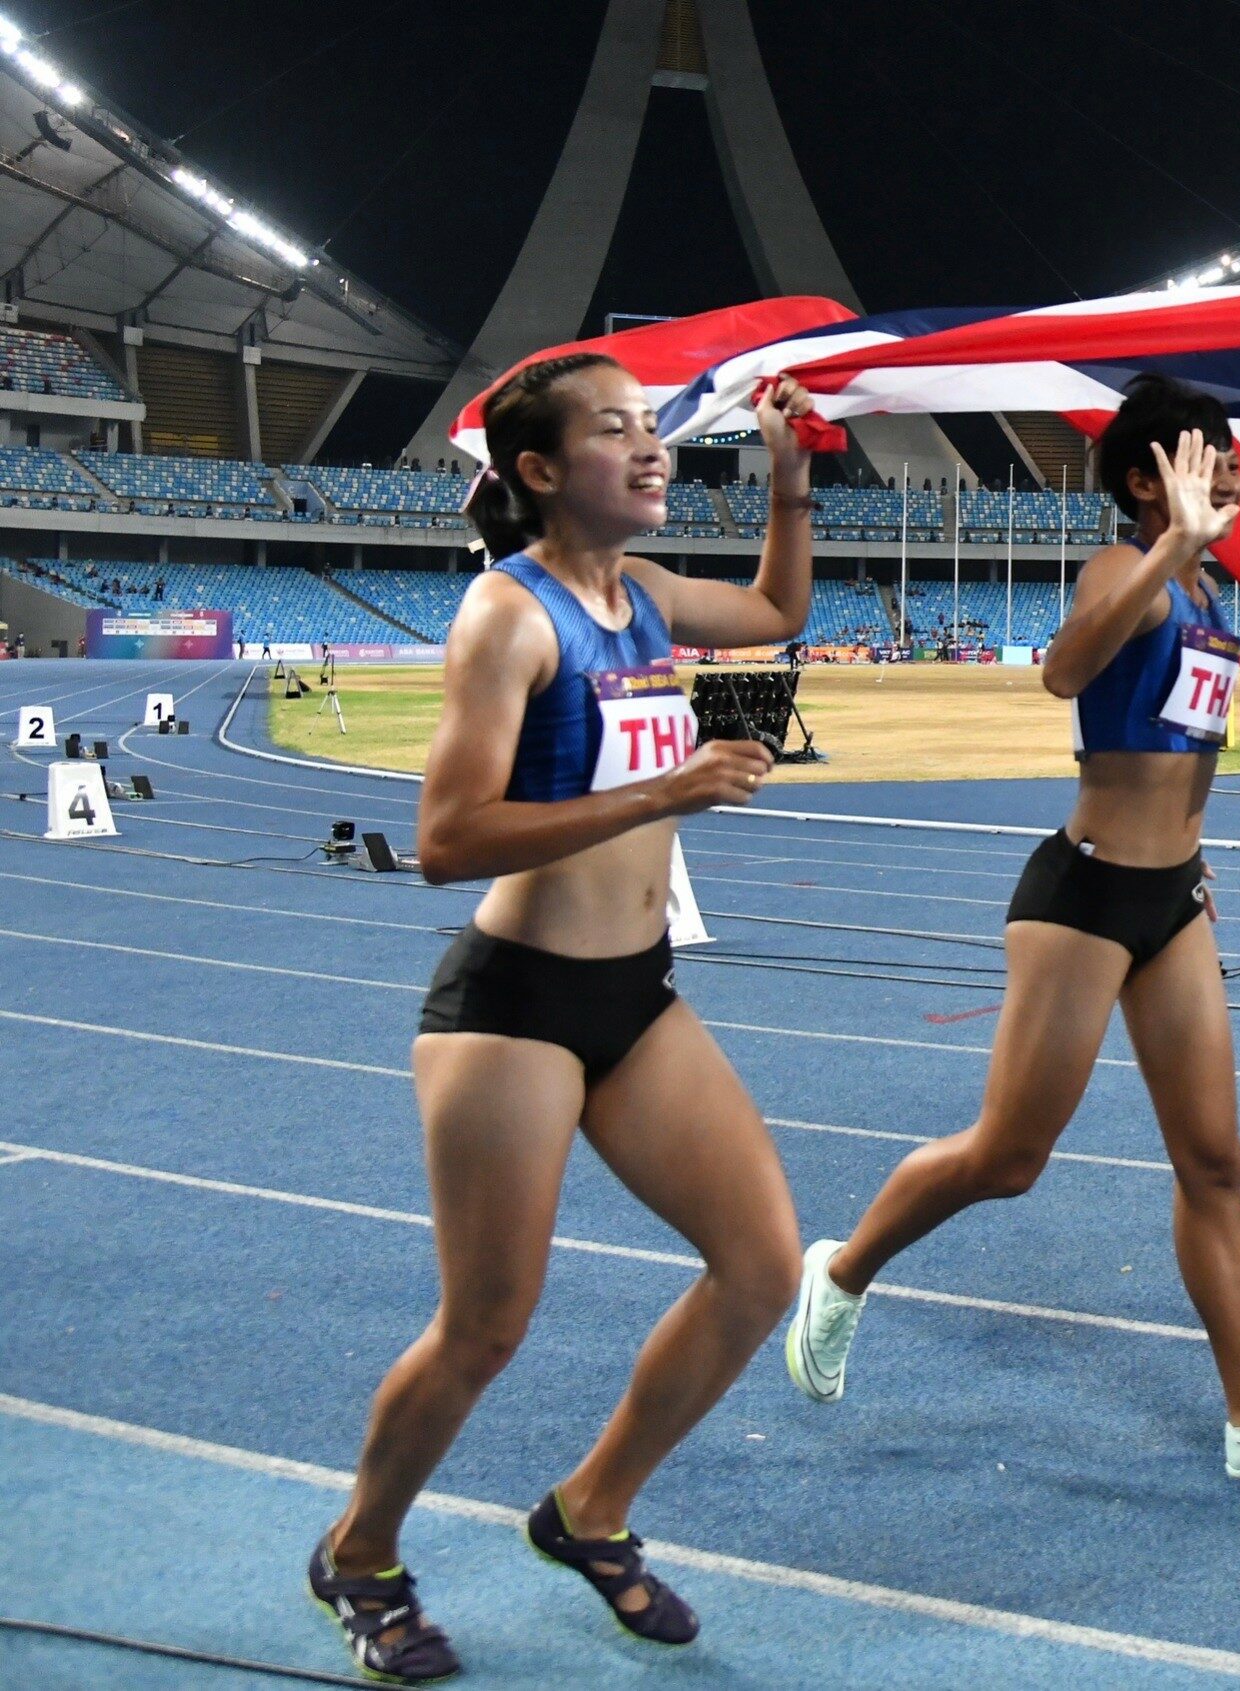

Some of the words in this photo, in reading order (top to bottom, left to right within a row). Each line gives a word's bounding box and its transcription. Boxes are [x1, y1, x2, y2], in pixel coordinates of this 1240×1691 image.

[678, 648, 701, 658] AIA
[153, 703, 162, 719] 1
[29, 717, 45, 739] 2
[68, 785, 96, 826] 4
